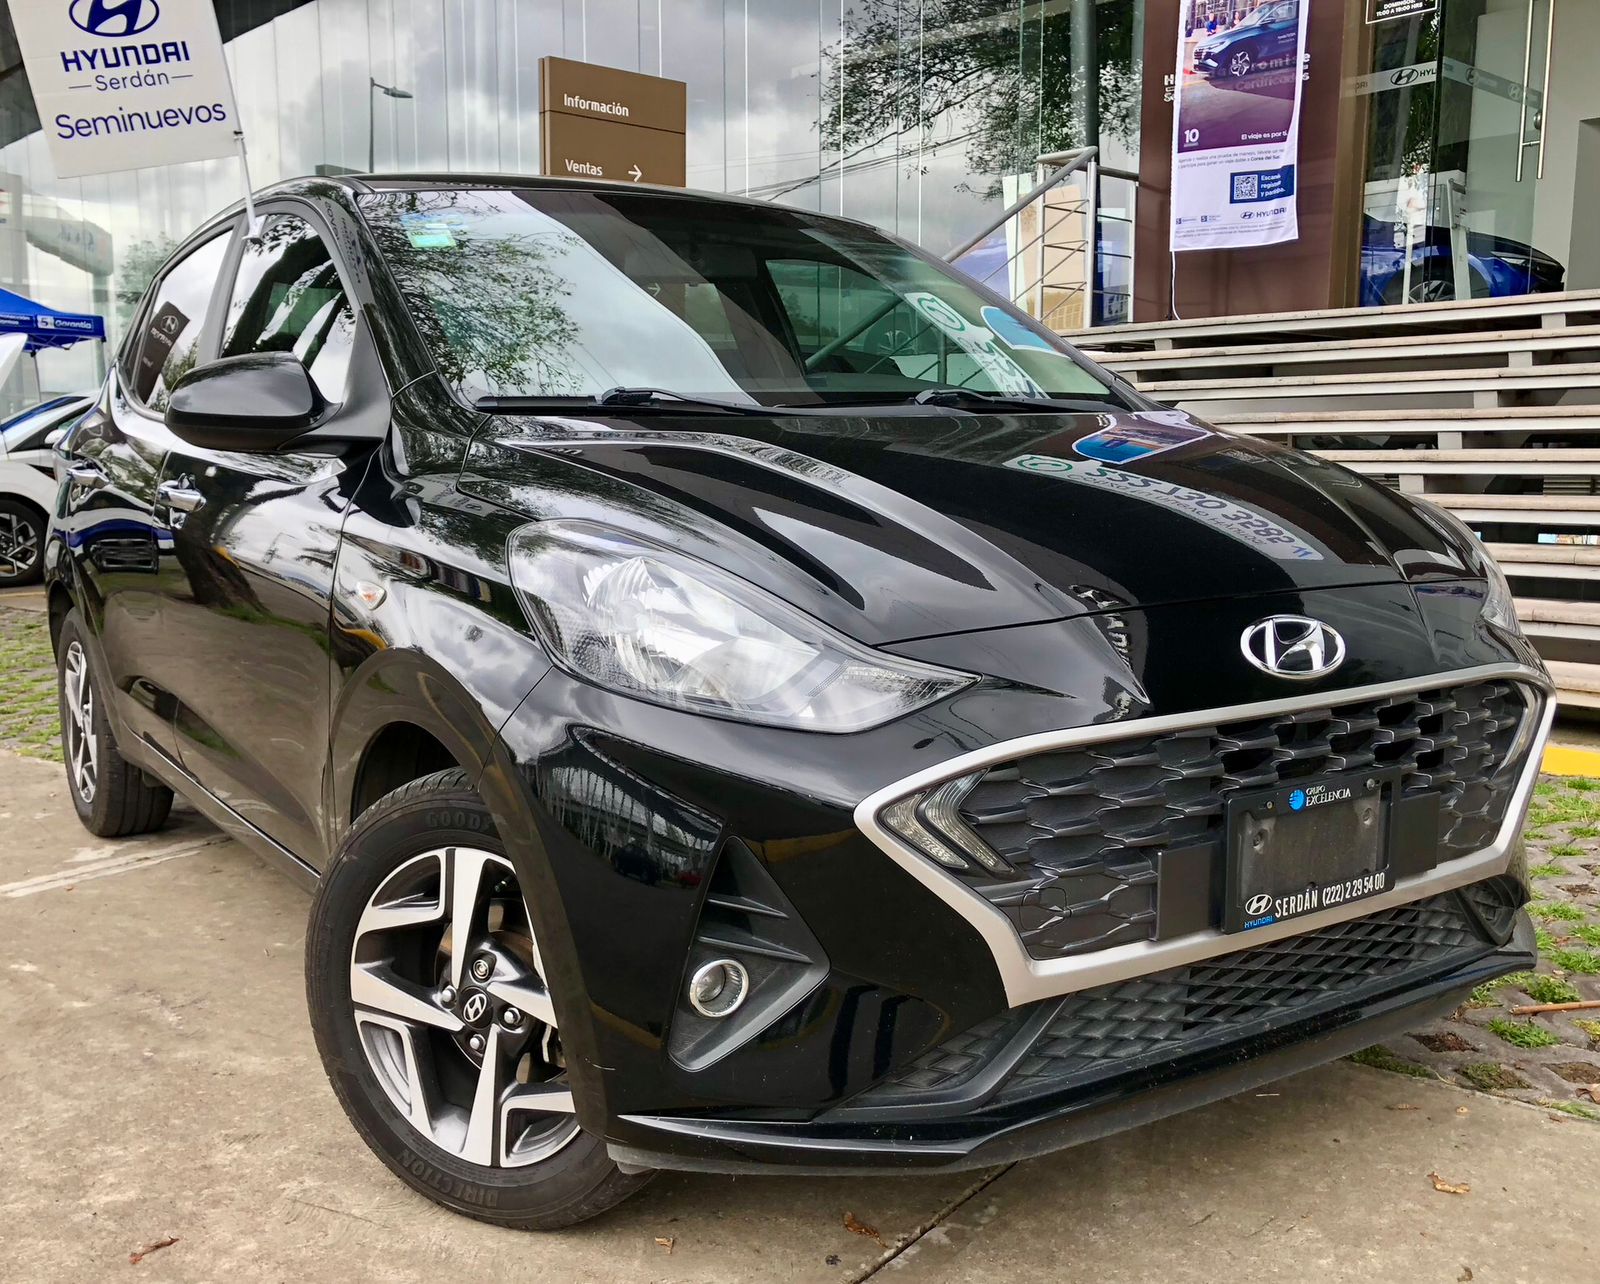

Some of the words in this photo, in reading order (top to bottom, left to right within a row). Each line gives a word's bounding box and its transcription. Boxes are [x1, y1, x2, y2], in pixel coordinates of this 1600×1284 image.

[60, 41, 190, 72] HYUNDAI
[95, 69, 170, 91] Serdán
[564, 93, 629, 117] Información
[55, 103, 226, 139] Seminuevos
[1183, 128, 1200, 143] 10
[1248, 132, 1262, 140] viaje
[1271, 131, 1282, 139] por
[565, 158, 603, 176] Ventas
[55, 319, 92, 329] Garantía
[1305, 784, 1326, 796] GRUPO
[1305, 788, 1351, 807] EXCELENCIA
[1275, 888, 1318, 918] SERDÁN
[1322, 883, 1345, 907] (222)
[1345, 883, 1351, 898] 2
[1244, 915, 1273, 929] HYUNDAI
